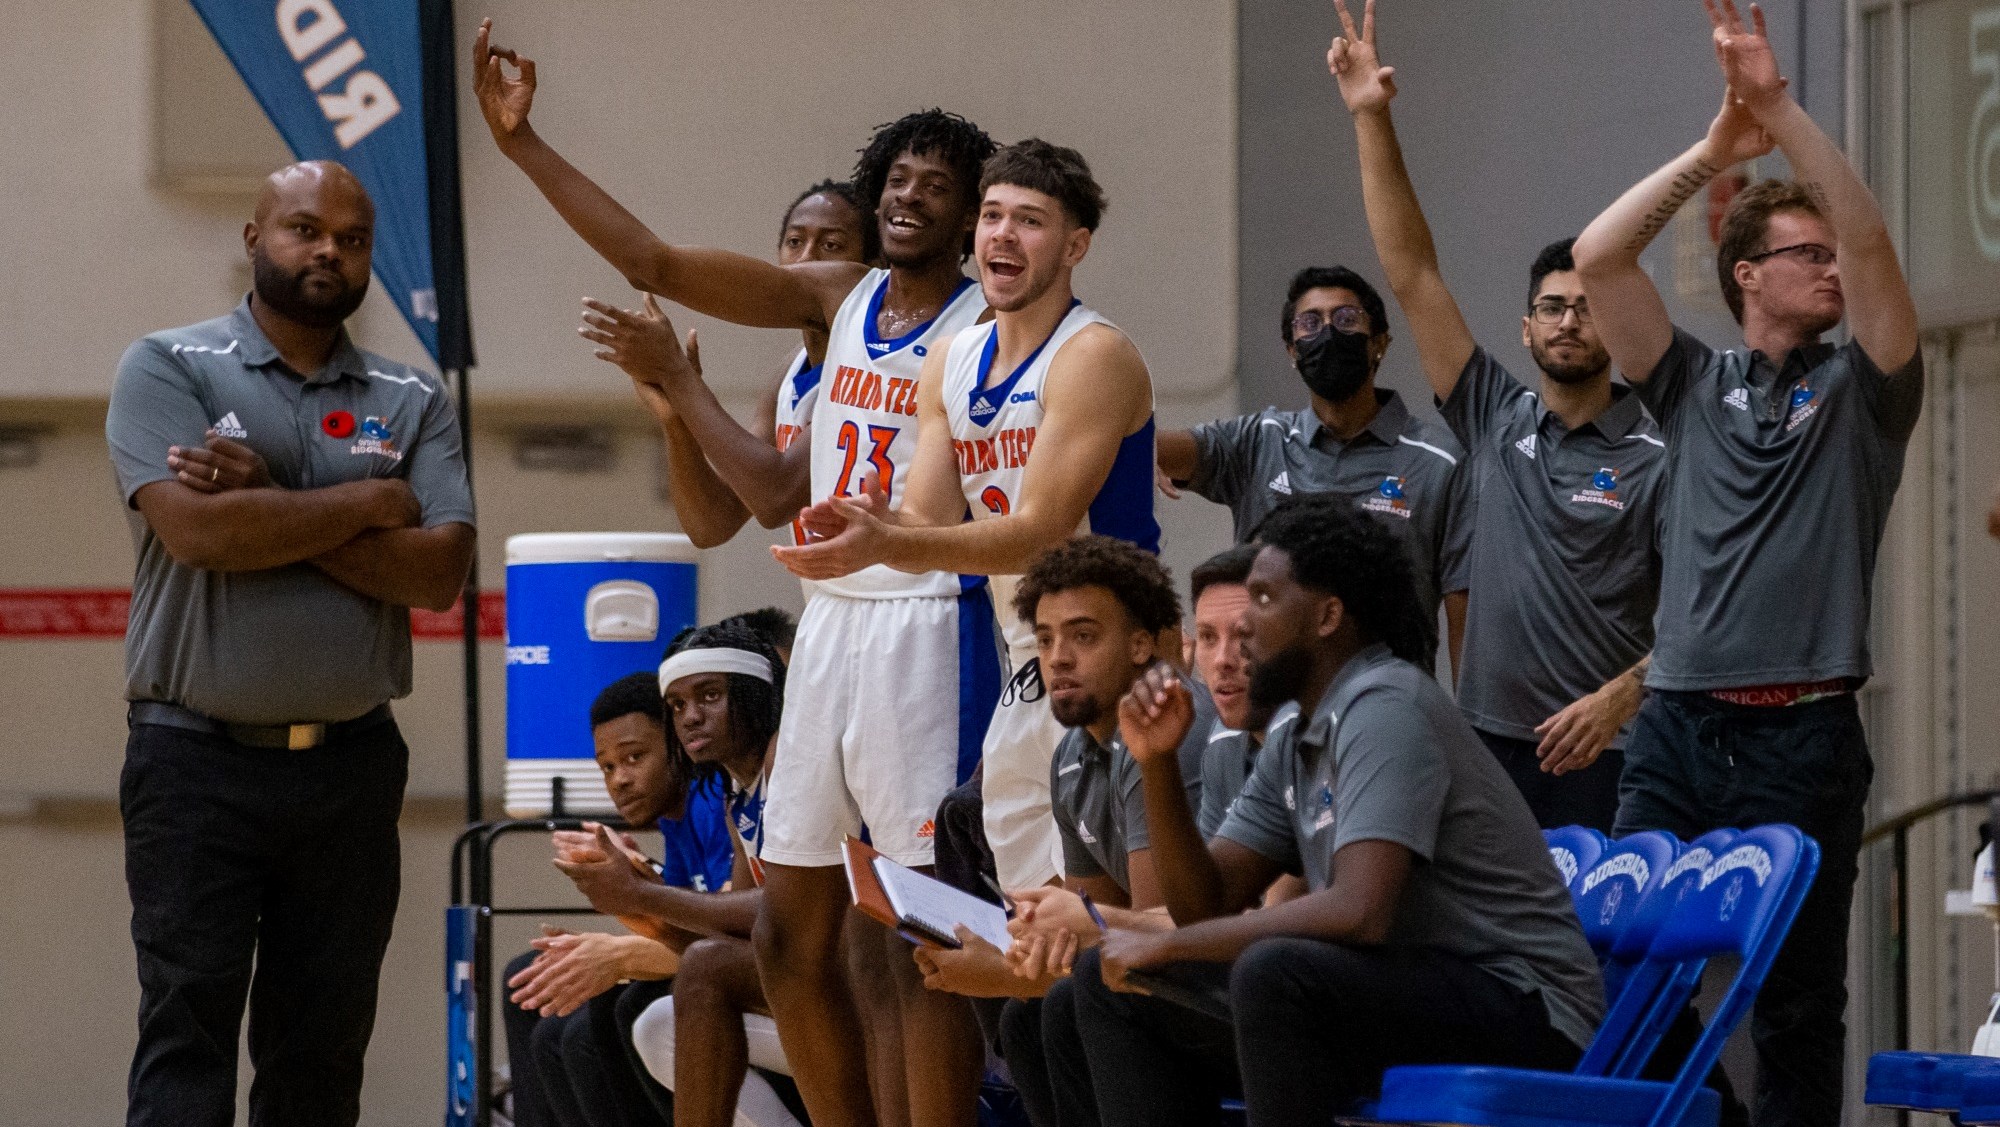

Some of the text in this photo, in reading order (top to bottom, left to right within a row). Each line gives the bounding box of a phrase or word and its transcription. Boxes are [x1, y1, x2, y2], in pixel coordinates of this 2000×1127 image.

[885, 376, 918, 417] TEC
[834, 420, 901, 503] 23
[1699, 845, 1772, 892] RIDGEBACKS
